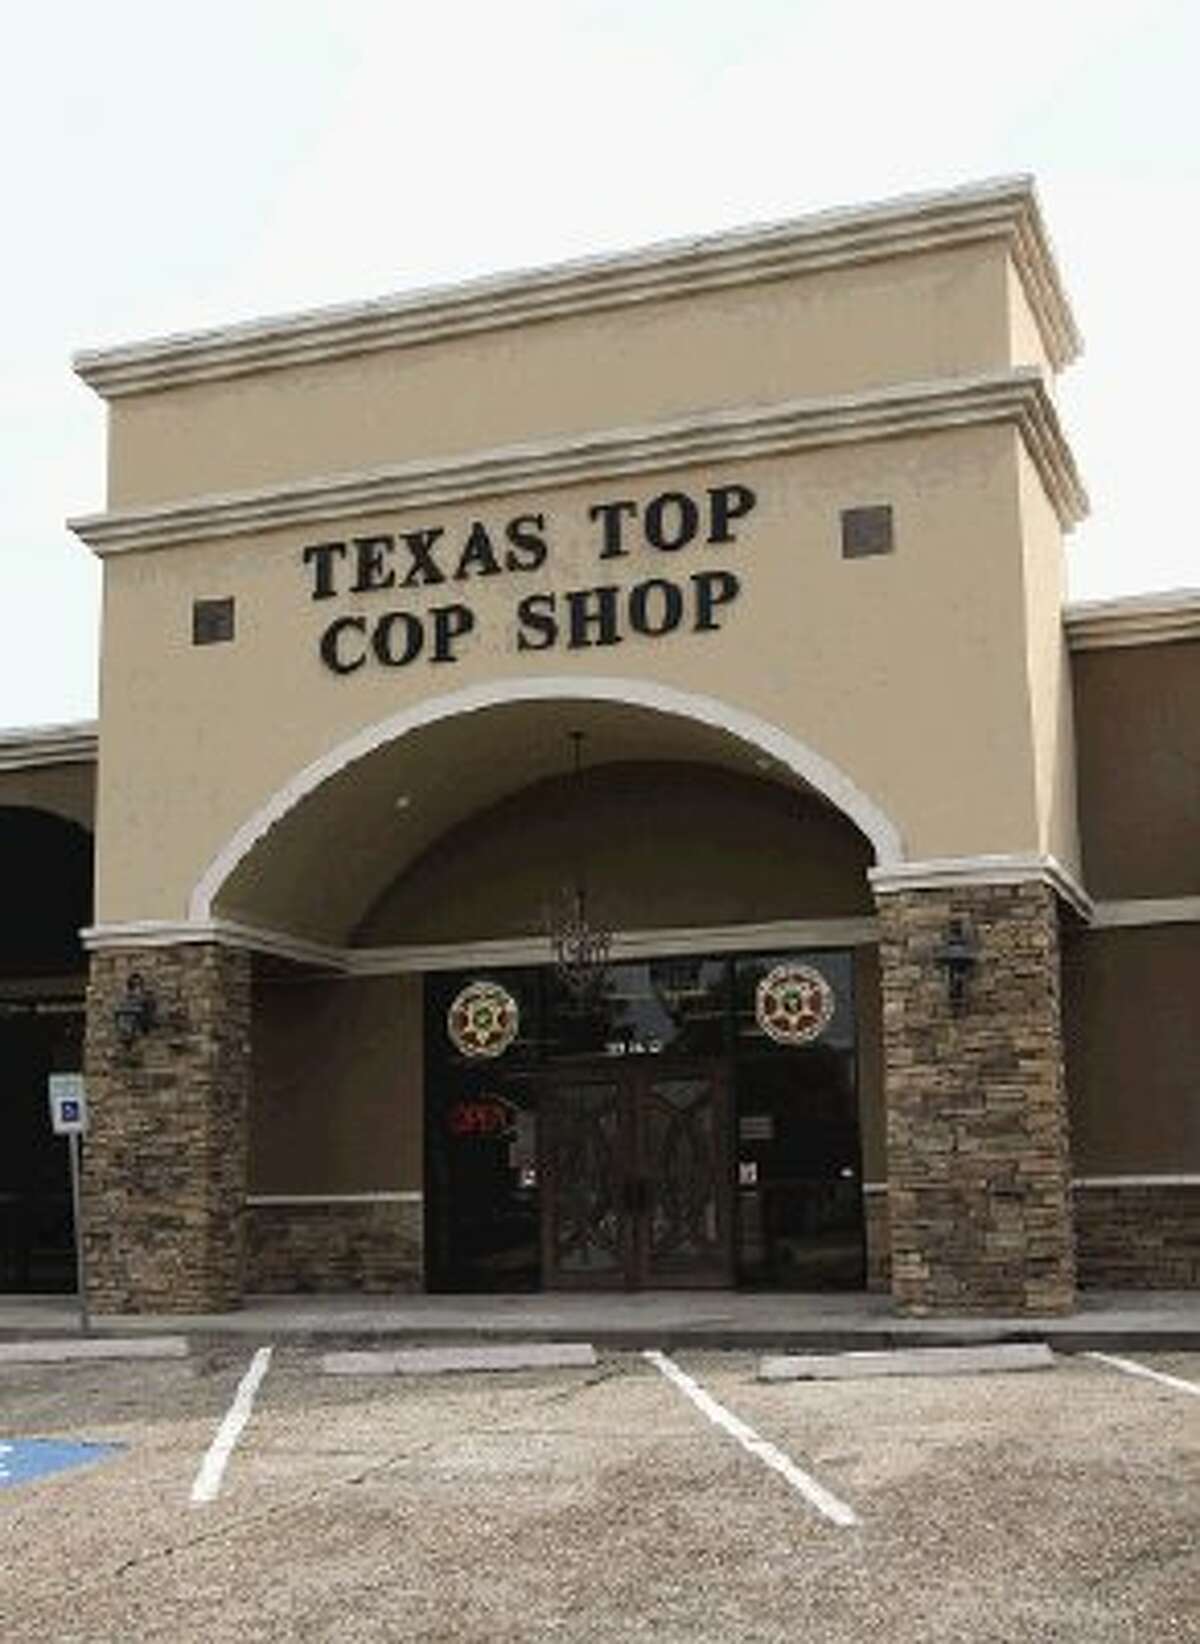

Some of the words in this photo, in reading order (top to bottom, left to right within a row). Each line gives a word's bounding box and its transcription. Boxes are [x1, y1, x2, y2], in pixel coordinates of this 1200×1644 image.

[303, 514, 548, 601] TEXAS
[589, 484, 756, 560] TOP
[320, 604, 475, 675] COP
[517, 571, 740, 652] SHOP
